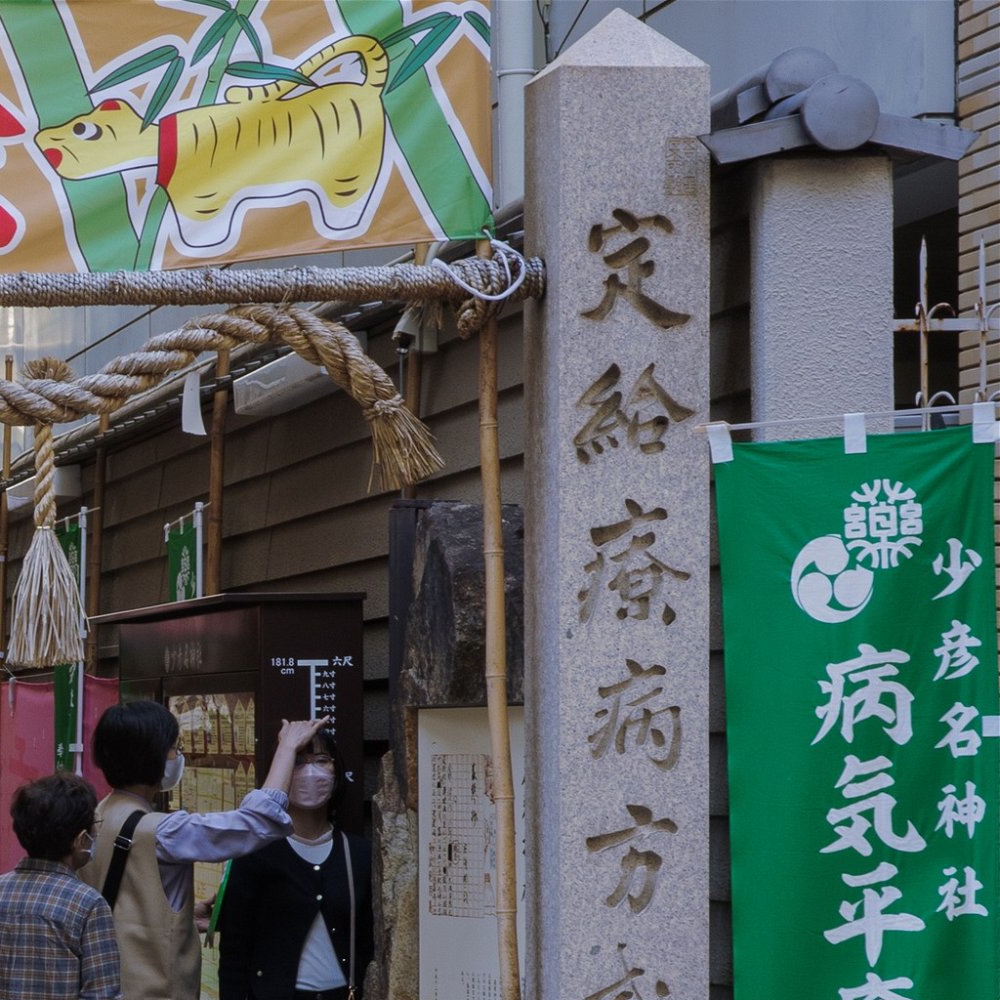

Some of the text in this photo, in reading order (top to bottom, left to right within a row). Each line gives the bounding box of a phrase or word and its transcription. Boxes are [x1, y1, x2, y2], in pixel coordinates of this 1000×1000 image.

[271, 657, 295, 667] 181.8
[332, 656, 354, 667] 六尺
[322, 682, 336, 690] 八寸
[932, 538, 989, 922] 少彦名神社
